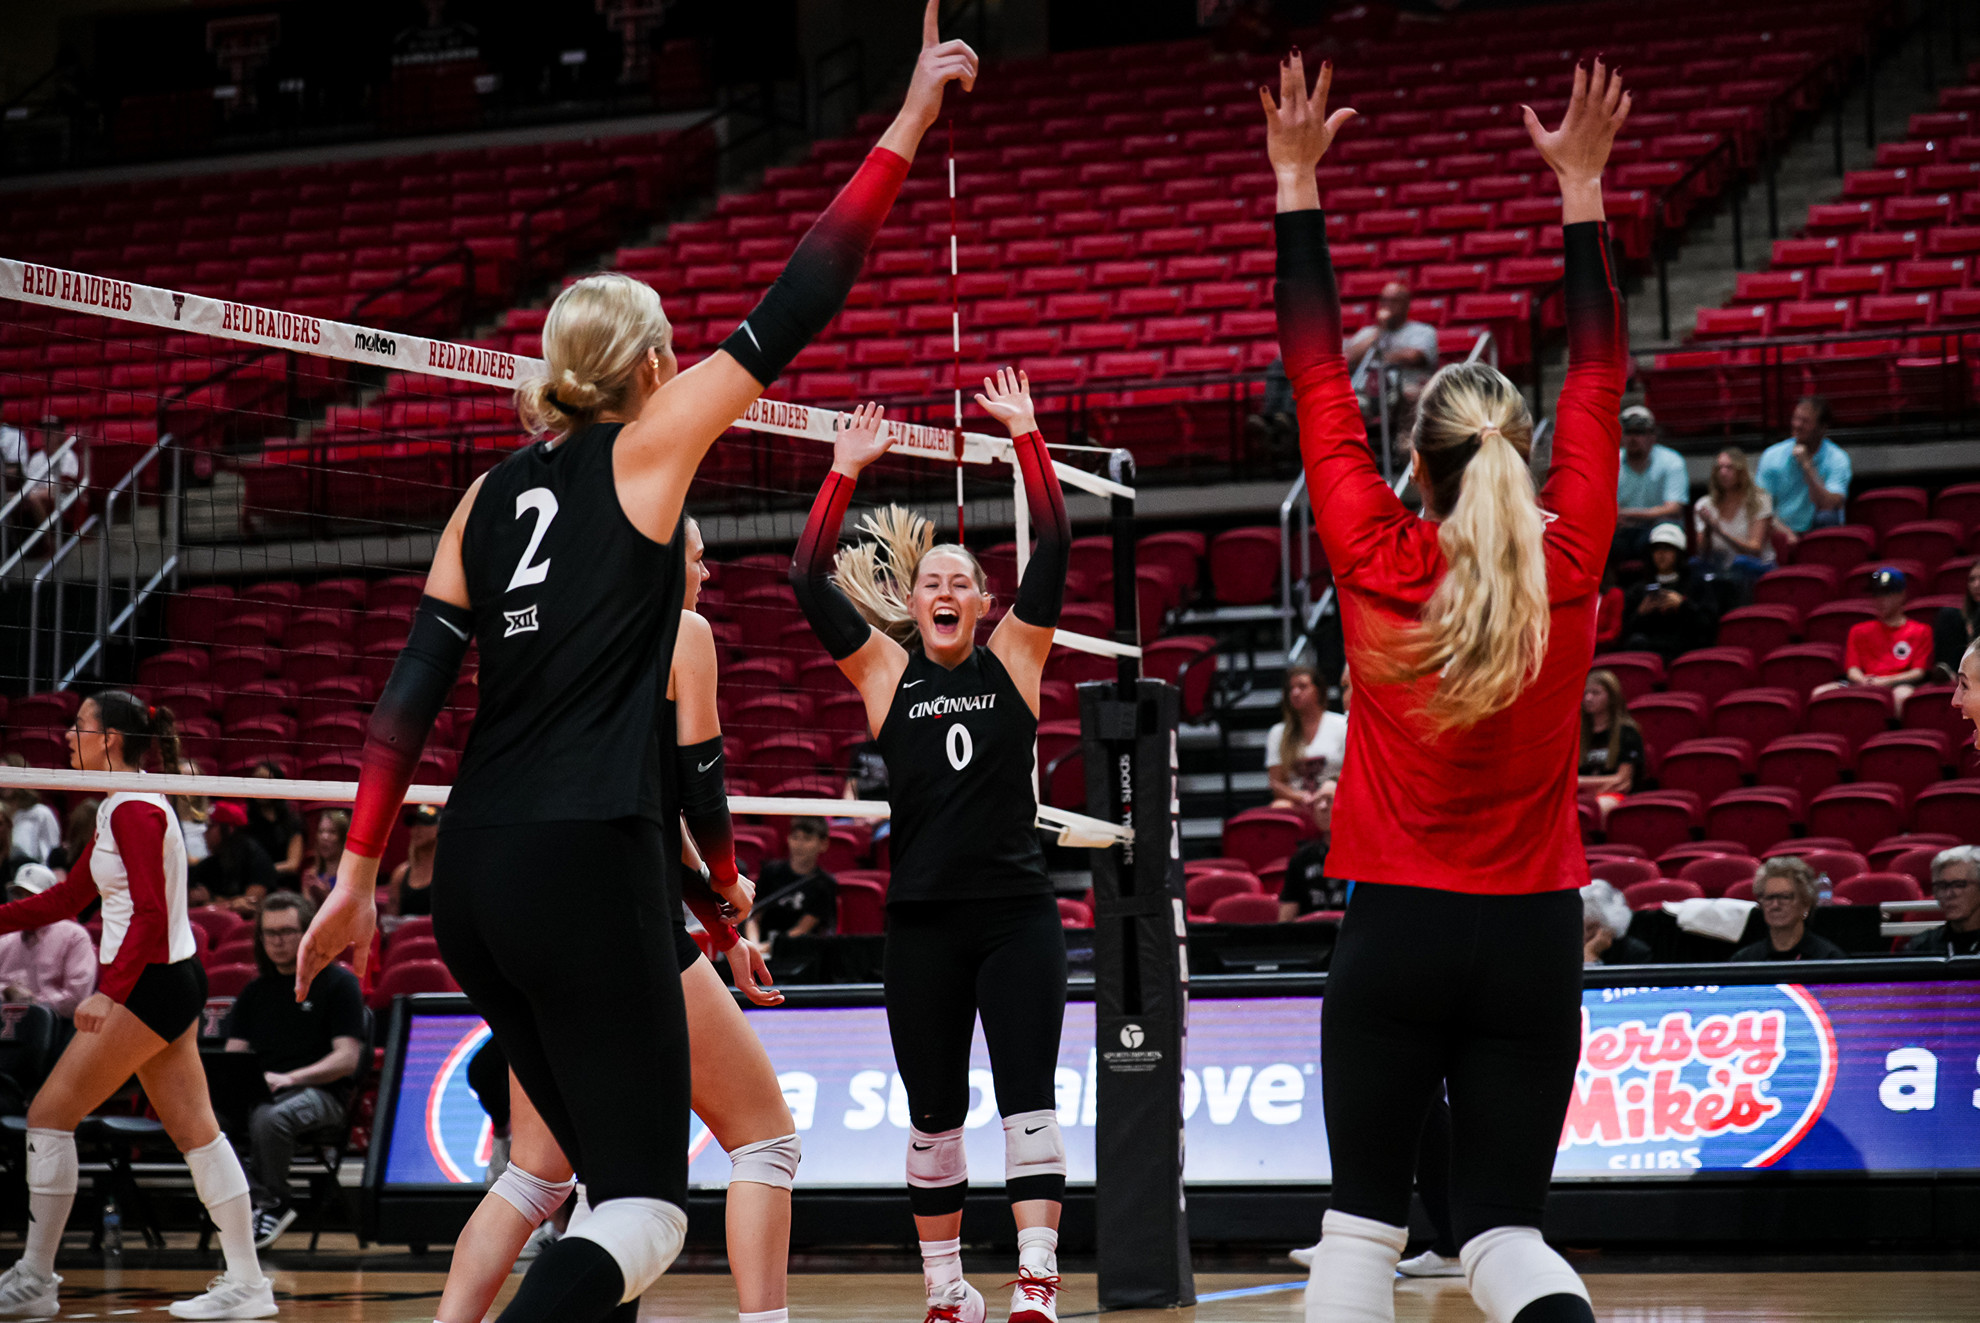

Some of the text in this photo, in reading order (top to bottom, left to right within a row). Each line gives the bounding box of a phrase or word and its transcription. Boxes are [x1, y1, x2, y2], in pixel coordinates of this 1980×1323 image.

[22, 264, 133, 312] RED RAIDERS
[222, 302, 321, 345] RED RAIDERS
[354, 332, 396, 356] molten
[429, 341, 515, 380] RED RAIDERS
[761, 401, 809, 430] RAIDERS
[504, 487, 559, 593] 2
[908, 693, 996, 719] CINCINNATI
[946, 722, 973, 771] 0
[1119, 753, 1133, 803] sports
[1583, 1012, 1786, 1079] ersey
[1879, 1047, 1938, 1110] a
[1559, 1068, 1780, 1147] Mike's
